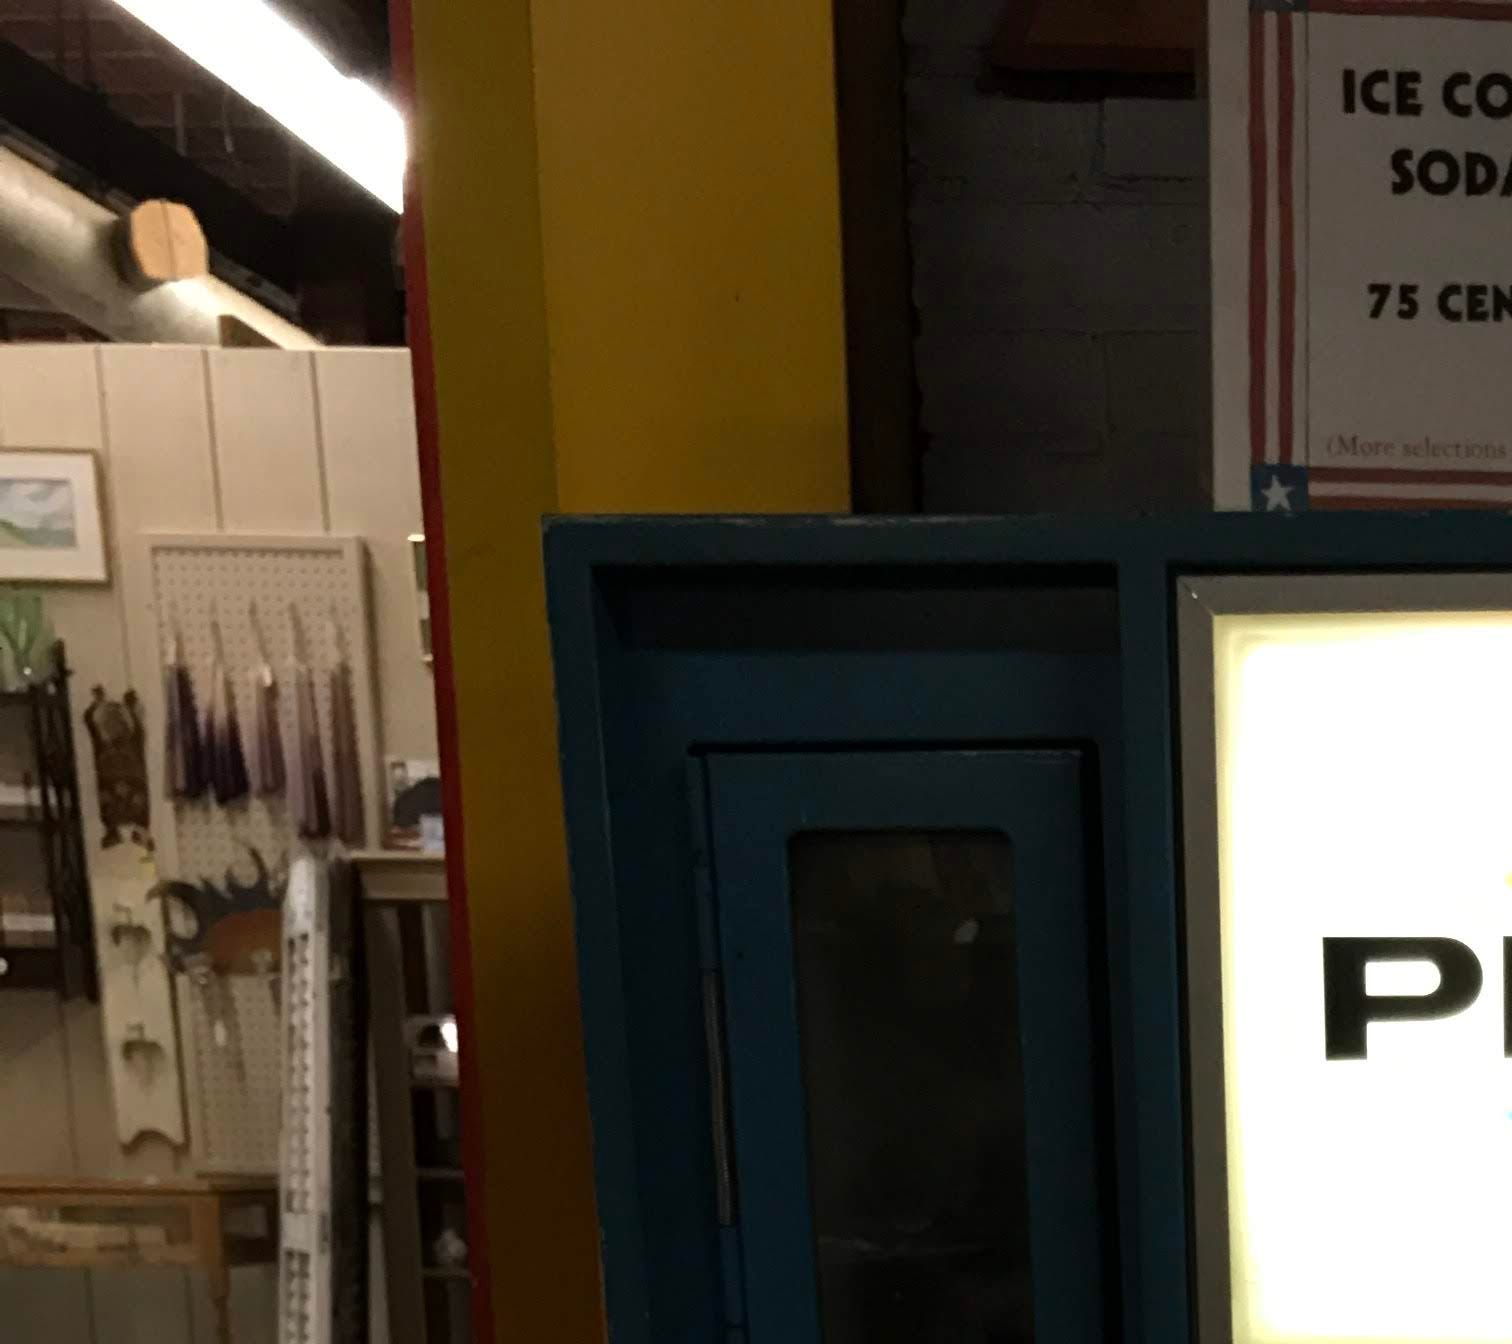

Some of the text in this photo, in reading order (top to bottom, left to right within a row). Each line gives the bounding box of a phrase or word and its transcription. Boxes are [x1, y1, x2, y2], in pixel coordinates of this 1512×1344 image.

[1342, 69, 1422, 116] ICE
[1368, 284, 1418, 319] 75
[1326, 434, 1396, 460] (More
[1402, 436, 1507, 460] selections
